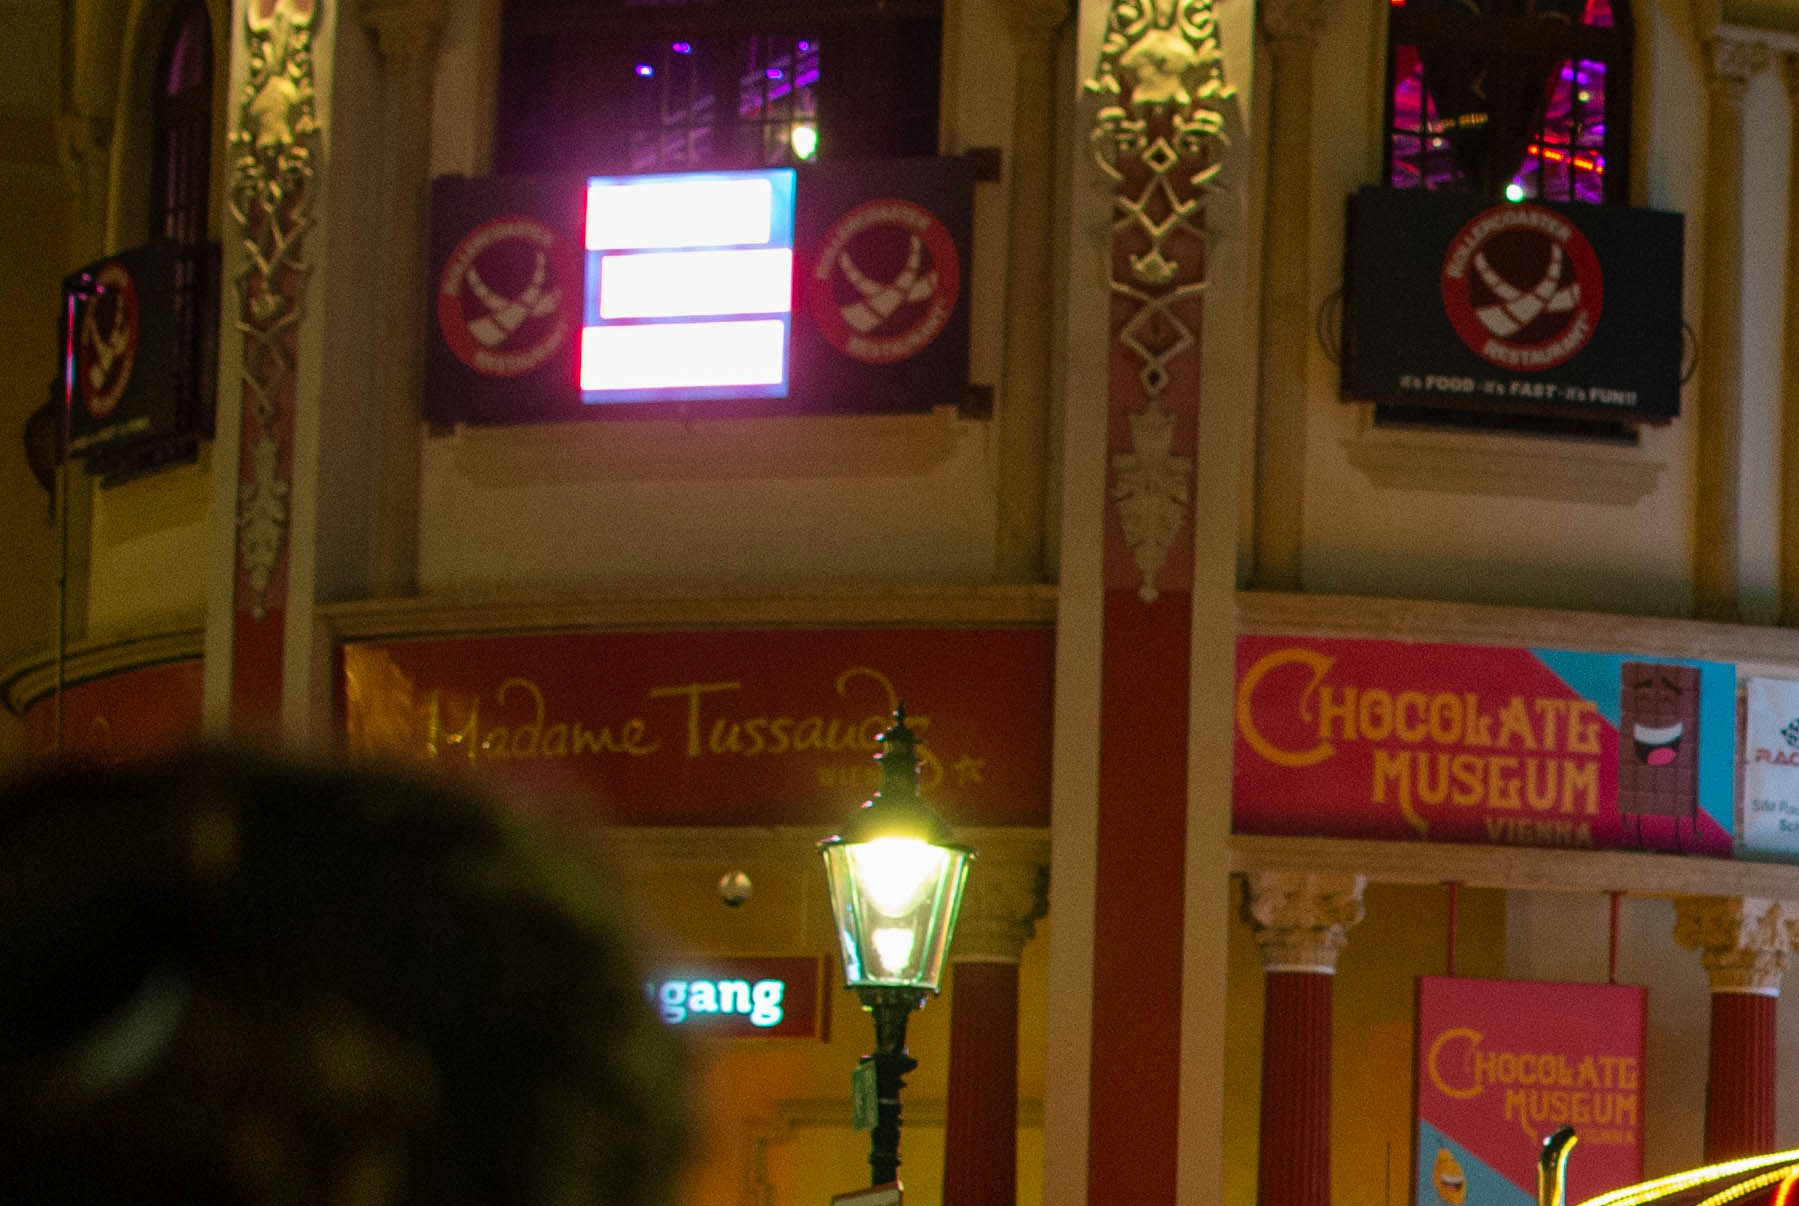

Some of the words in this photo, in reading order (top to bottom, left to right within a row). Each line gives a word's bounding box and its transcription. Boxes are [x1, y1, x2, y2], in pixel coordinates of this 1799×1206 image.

[1424, 375, 1475, 393] FOOD
[1509, 380, 1558, 399] FAST
[427, 676, 661, 759] Madame
[1236, 648, 1602, 768] CHOCOLATE
[1371, 748, 1601, 840] MUSEUM
[1483, 814, 1594, 847] VIENNA
[647, 979, 785, 1027] gang
[1428, 1027, 1639, 1099] CHOCOLATE
[1505, 1087, 1638, 1146] MUSEUM
